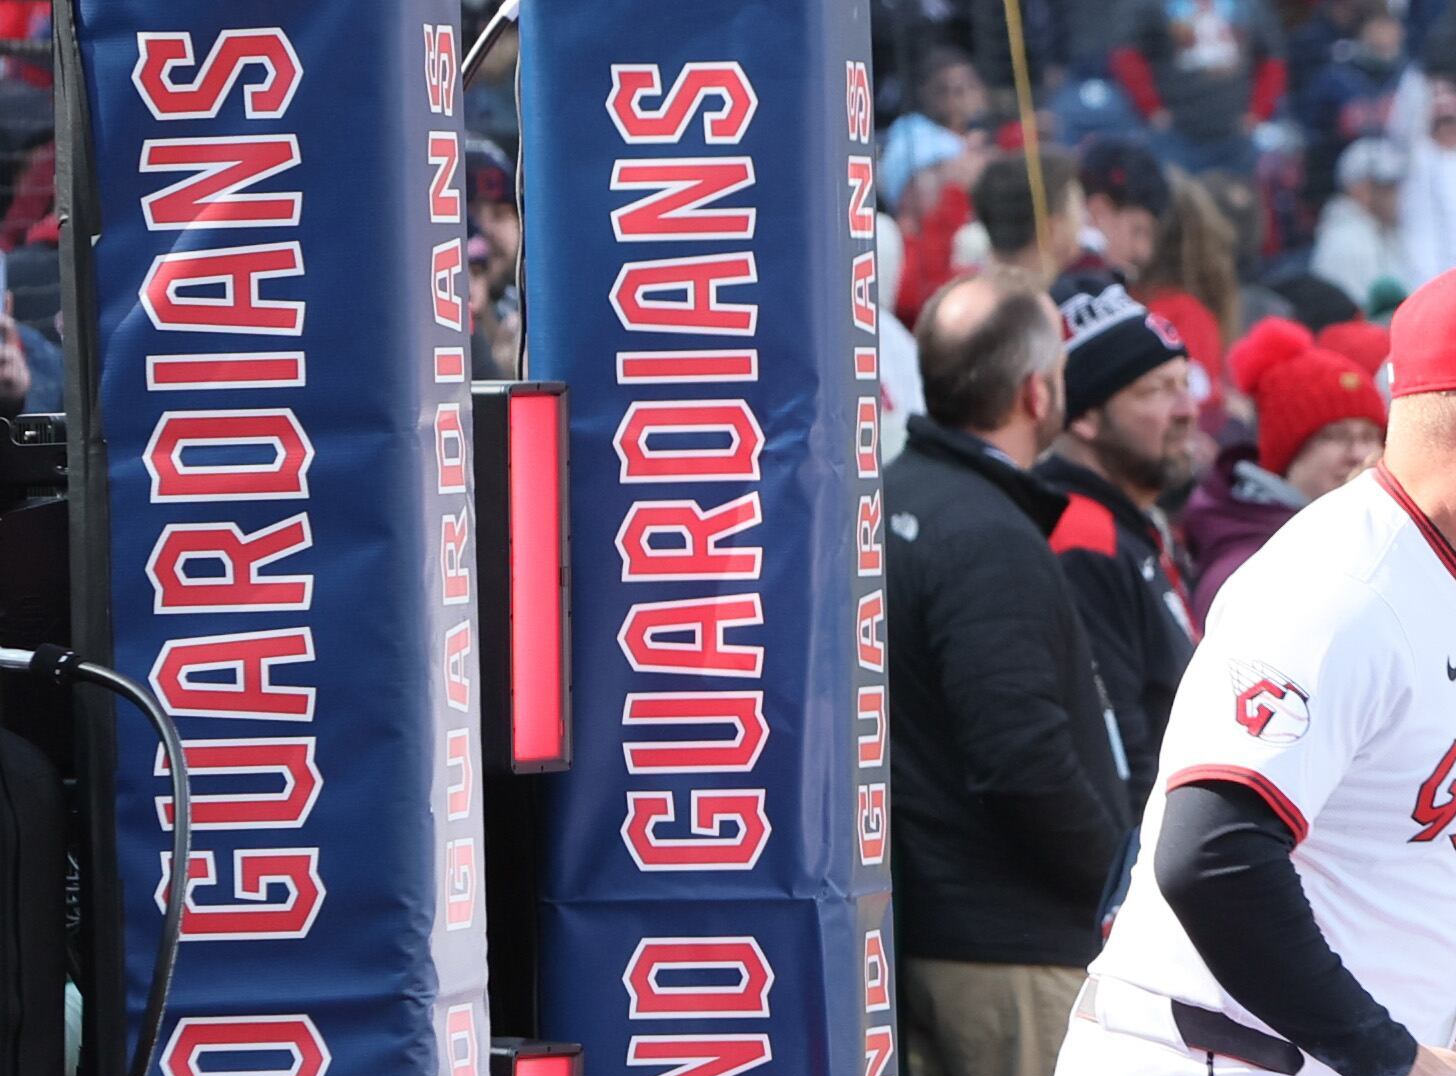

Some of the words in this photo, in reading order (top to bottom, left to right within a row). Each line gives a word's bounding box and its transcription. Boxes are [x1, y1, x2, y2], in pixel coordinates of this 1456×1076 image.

[131, 26, 327, 941] GUARDIANS
[423, 23, 477, 932] GUARDIANS
[606, 60, 773, 871] GUARDIANS
[846, 59, 890, 867] GUARDIANS
